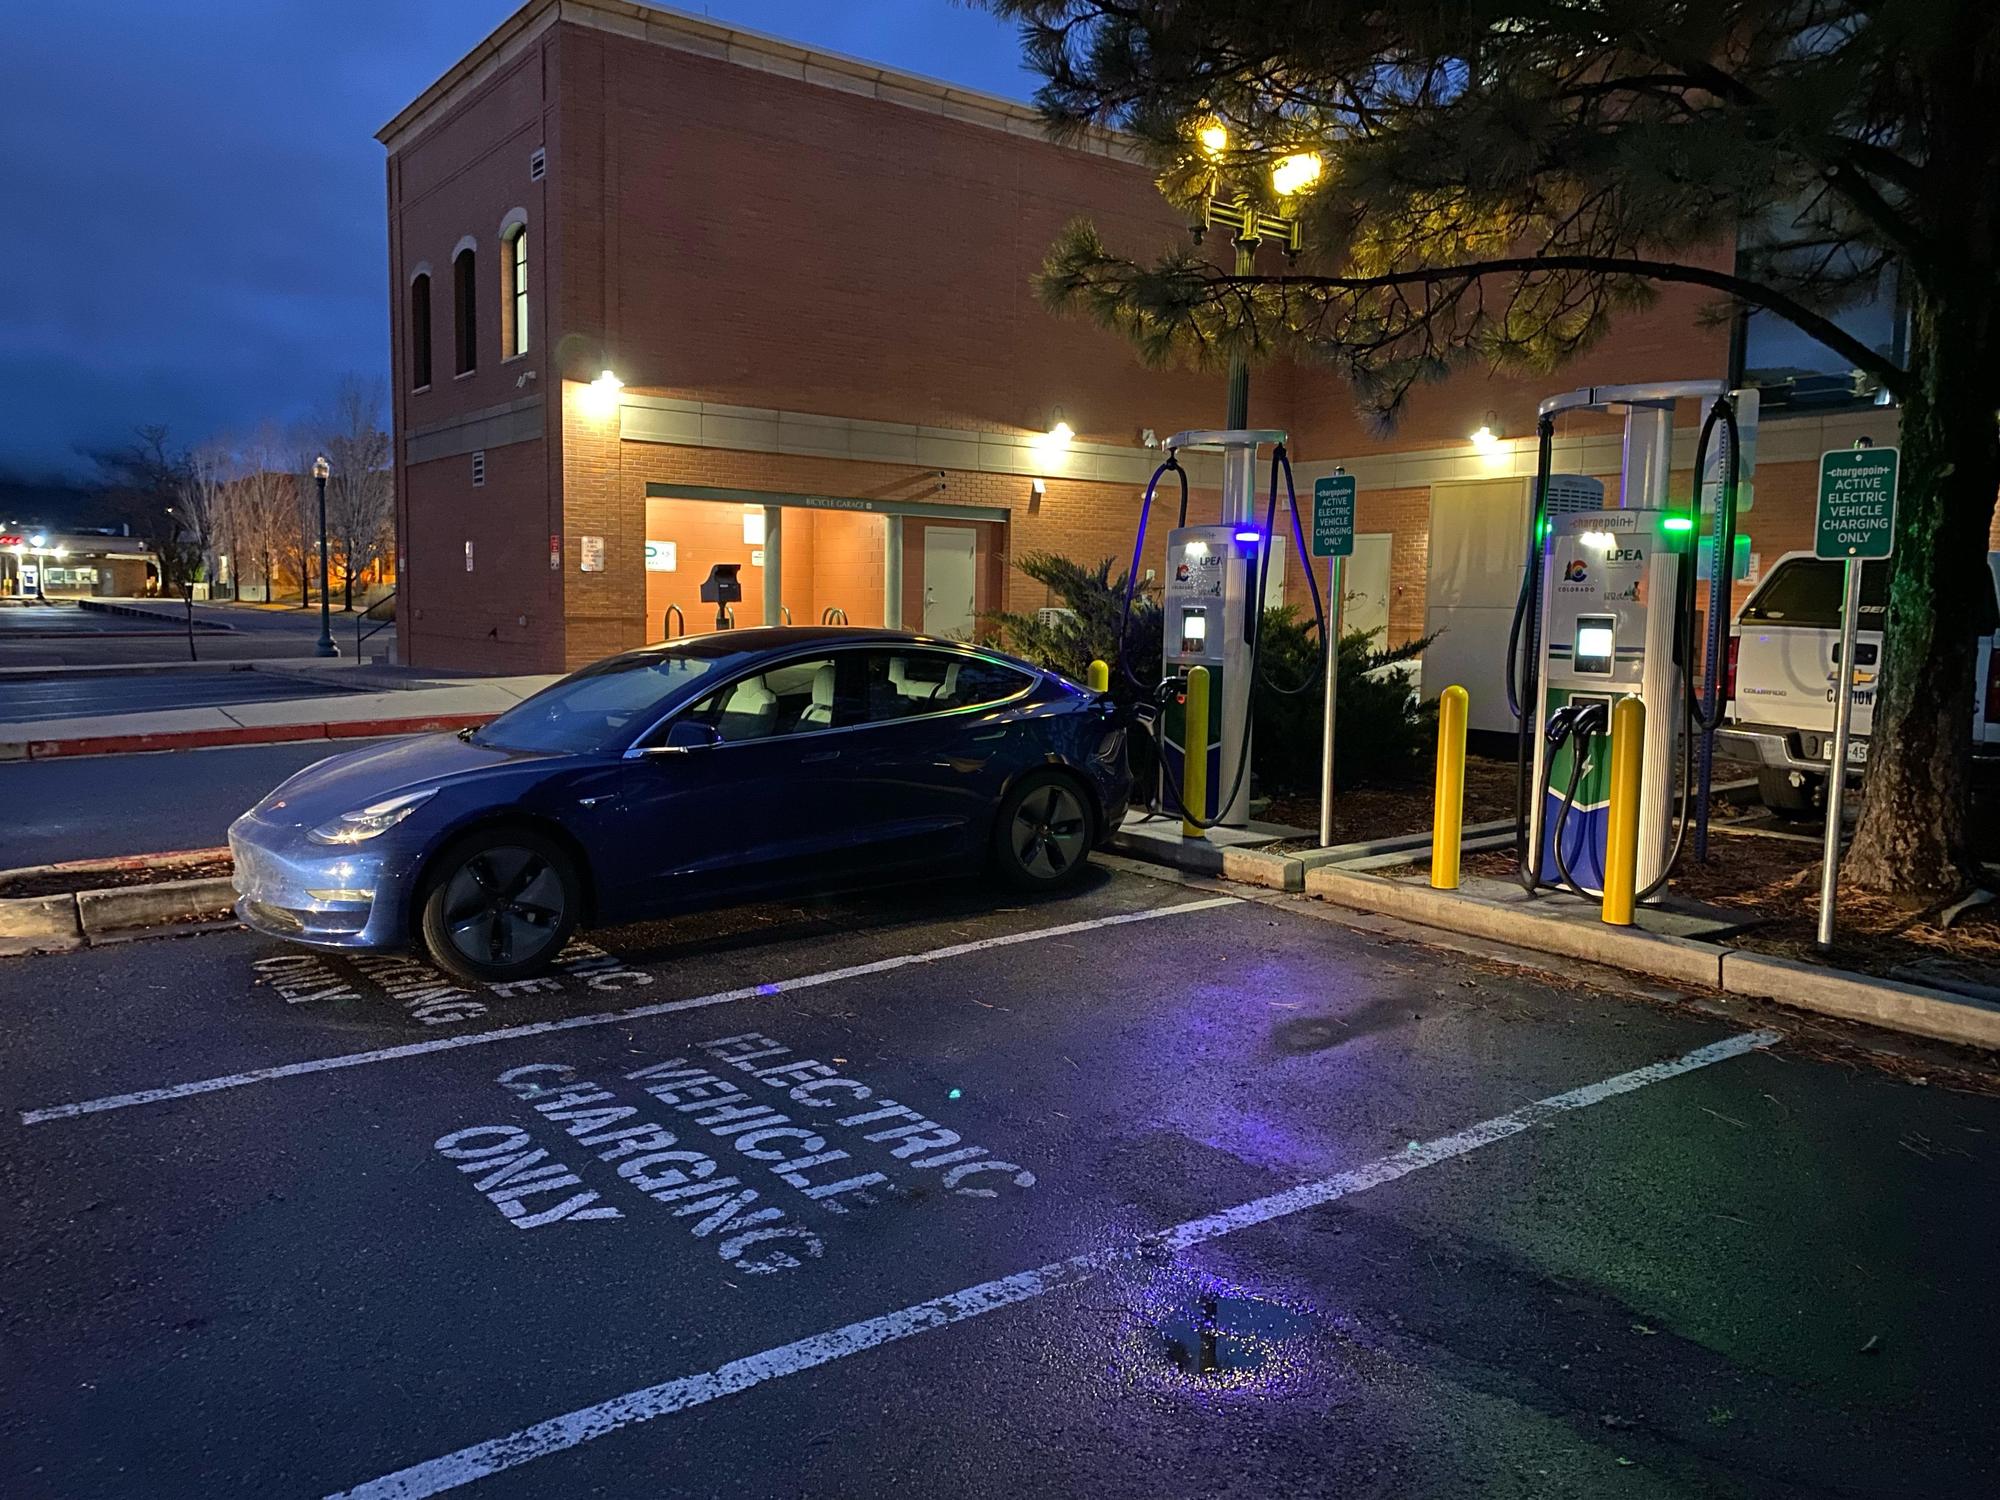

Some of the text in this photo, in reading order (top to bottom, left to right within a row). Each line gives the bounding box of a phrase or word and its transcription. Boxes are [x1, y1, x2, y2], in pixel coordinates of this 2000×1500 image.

[1835, 477, 1881, 490] ACTIVE
[1322, 496, 1347, 506] ACTIVE
[1828, 491, 1887, 504] ELECTRIC
[836, 500, 864, 508] GARAGE
[1318, 507, 1350, 517] ELECTRIC
[1830, 505, 1883, 517] VEHICLE
[1319, 516, 1348, 526] VEHICLE
[1822, 518, 1888, 531] CHARGING
[1315, 526, 1352, 536] CHARGING
[1324, 537, 1342, 546] ONLY
[1837, 532, 1871, 543] ONLY
[1606, 549, 1643, 561] LPEA
[696, 1032, 1036, 1198] ELECTRIC
[624, 1057, 894, 1214] VEHICLE
[497, 1063, 825, 1274] CHARGING
[434, 1125, 626, 1229] ONLY
